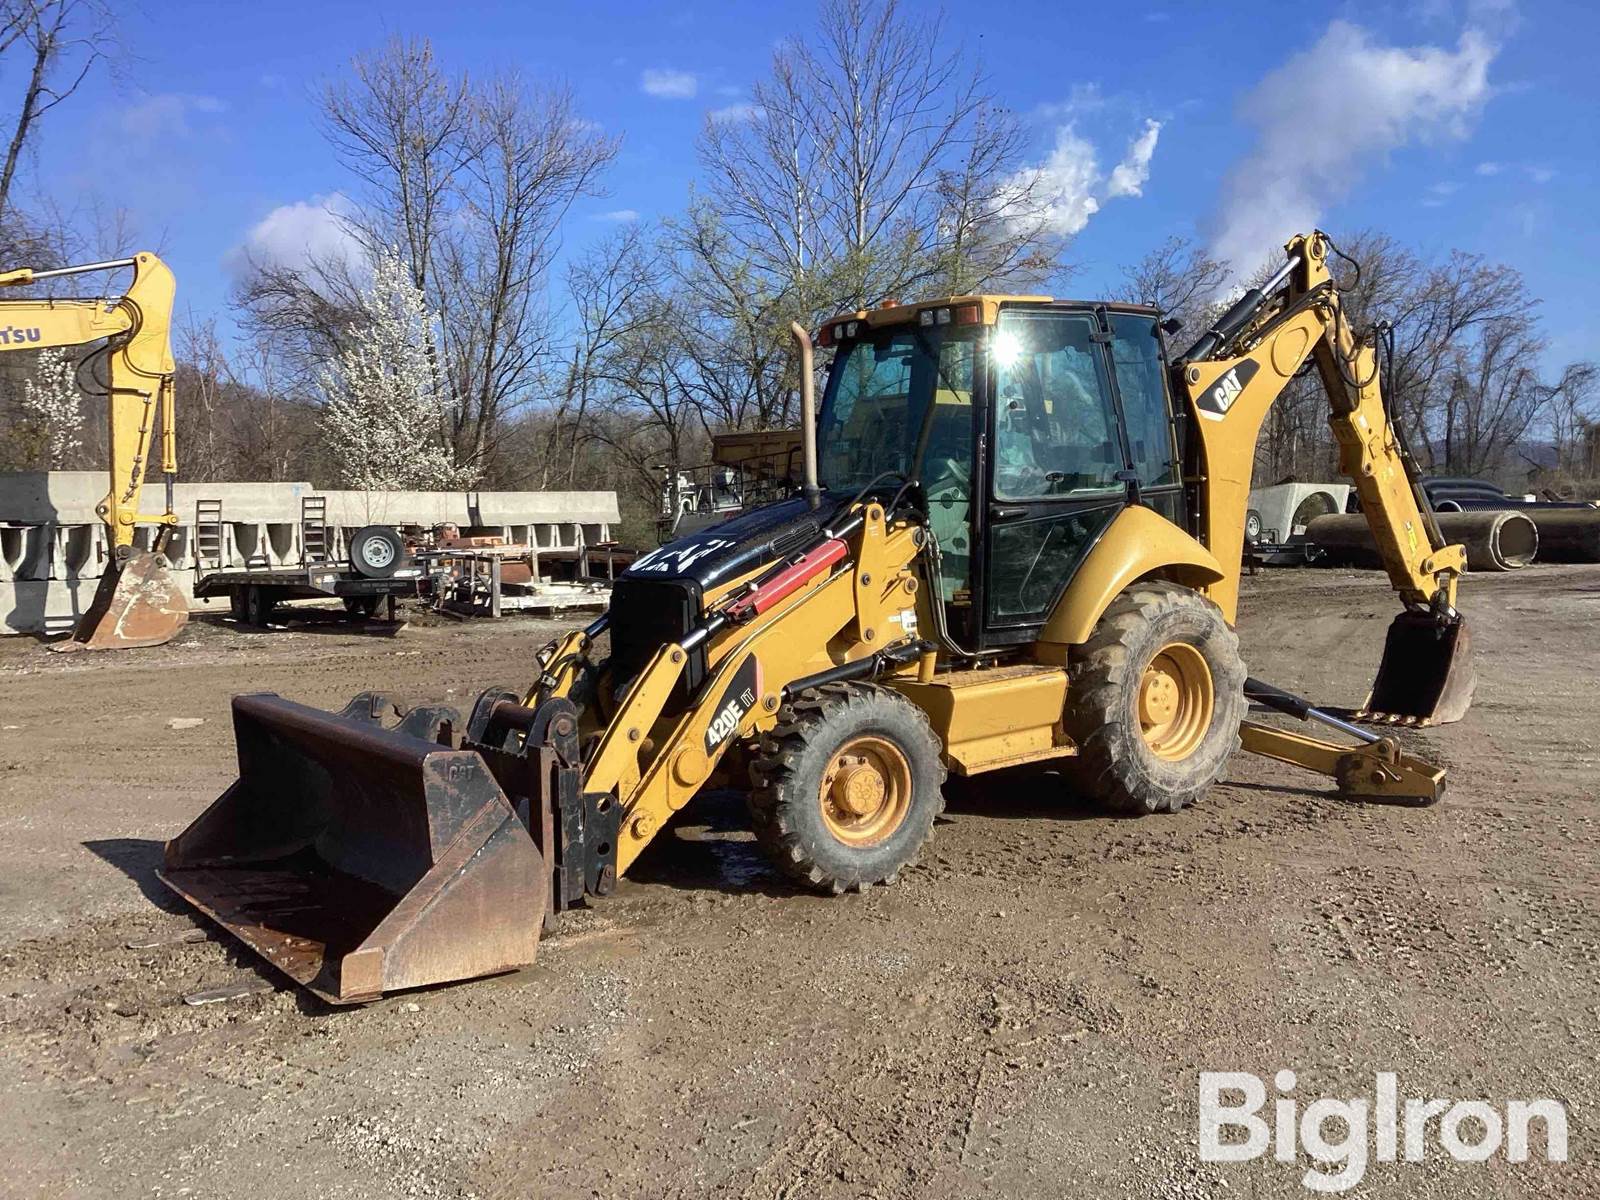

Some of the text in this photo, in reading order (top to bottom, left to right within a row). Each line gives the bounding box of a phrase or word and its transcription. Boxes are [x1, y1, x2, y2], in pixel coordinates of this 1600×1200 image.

[0, 325, 41, 345] TSU
[1214, 368, 1243, 411] CAT
[707, 700, 744, 746] 420E
